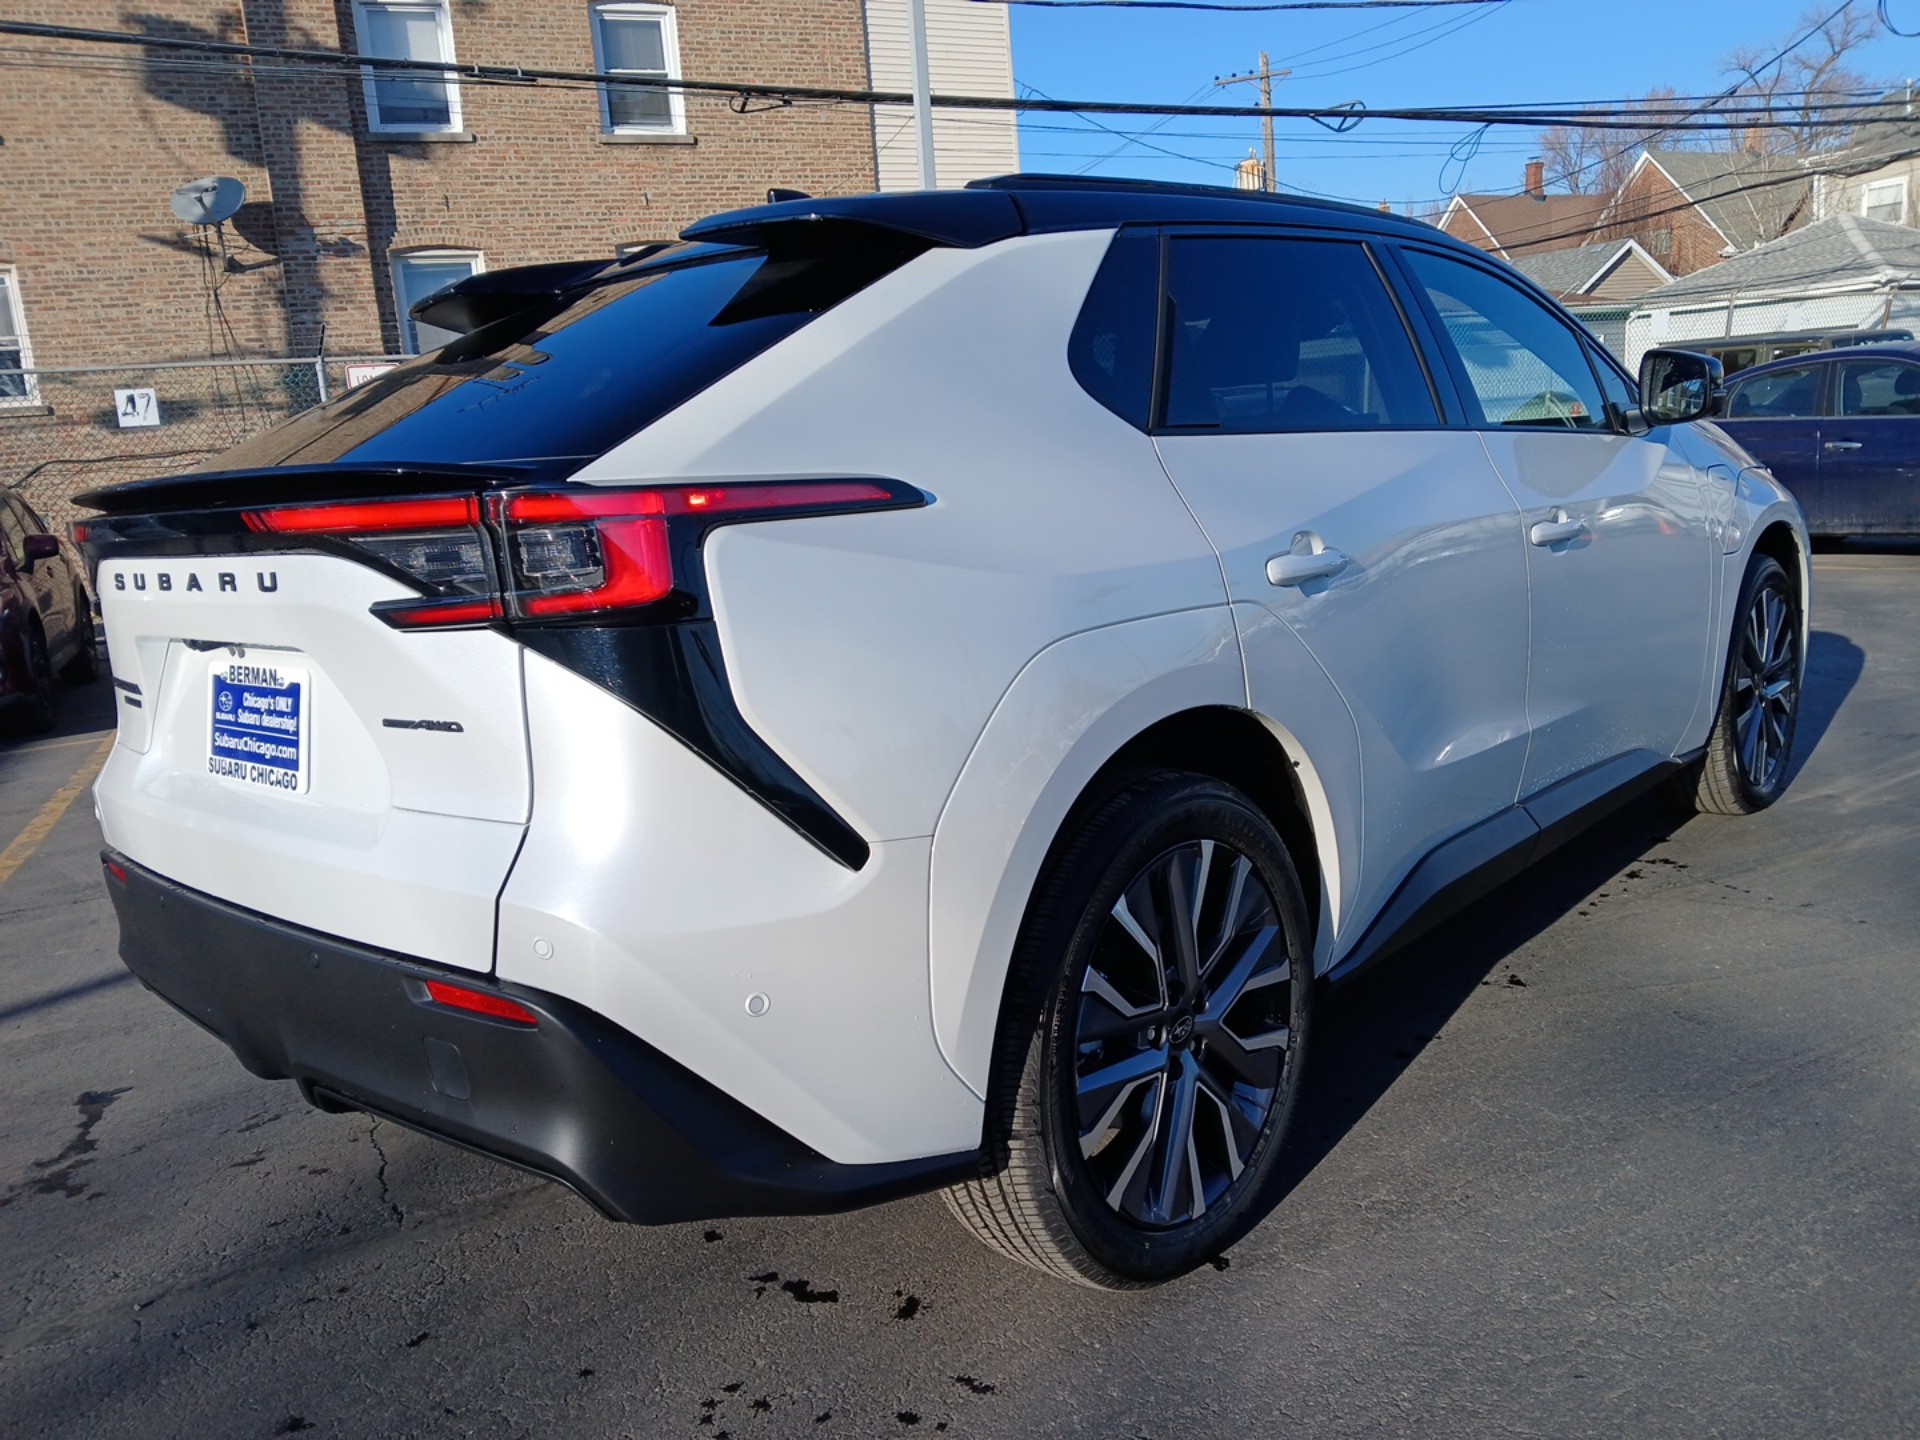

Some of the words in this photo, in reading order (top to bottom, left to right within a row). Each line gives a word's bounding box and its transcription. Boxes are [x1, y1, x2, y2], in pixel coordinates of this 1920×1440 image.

[114, 571, 278, 593] SUBARU
[229, 665, 277, 687] BERMAN
[243, 692, 274, 712] Chicago's
[275, 696, 292, 712] ONLY
[237, 708, 260, 726] Subaru
[214, 731, 297, 760] SubaruChicago.com
[208, 757, 247, 780] SUBARU
[250, 765, 297, 791] CHICAGO
